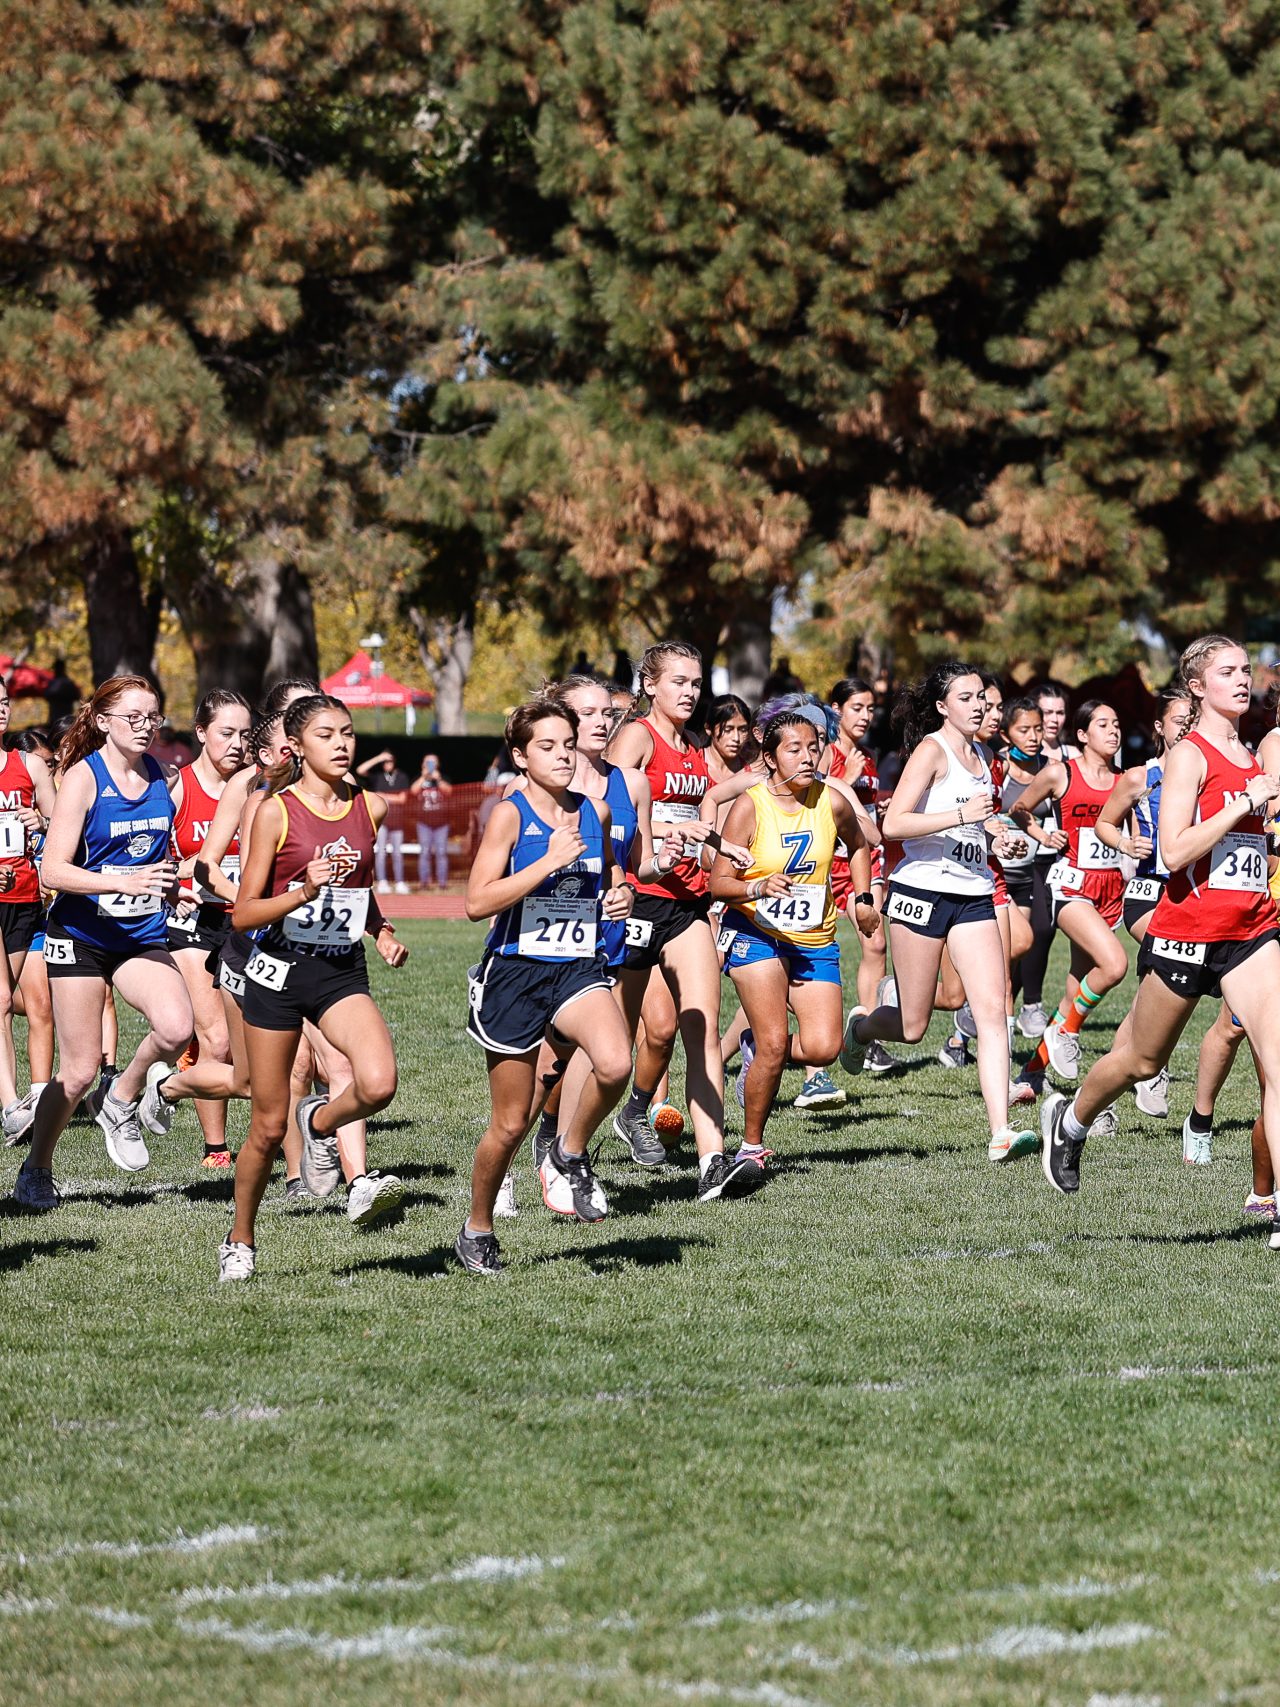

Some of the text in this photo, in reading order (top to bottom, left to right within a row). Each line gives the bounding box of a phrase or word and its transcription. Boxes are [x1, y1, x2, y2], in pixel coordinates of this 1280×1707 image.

[780, 830, 816, 875] Z
[952, 841, 982, 865] 408
[1224, 851, 1262, 879] 348
[1129, 881, 1152, 896] 298
[297, 904, 352, 932] 392
[767, 898, 811, 921] 443
[894, 900, 924, 919] 408
[535, 916, 585, 944] 276
[225, 971, 246, 989] 27
